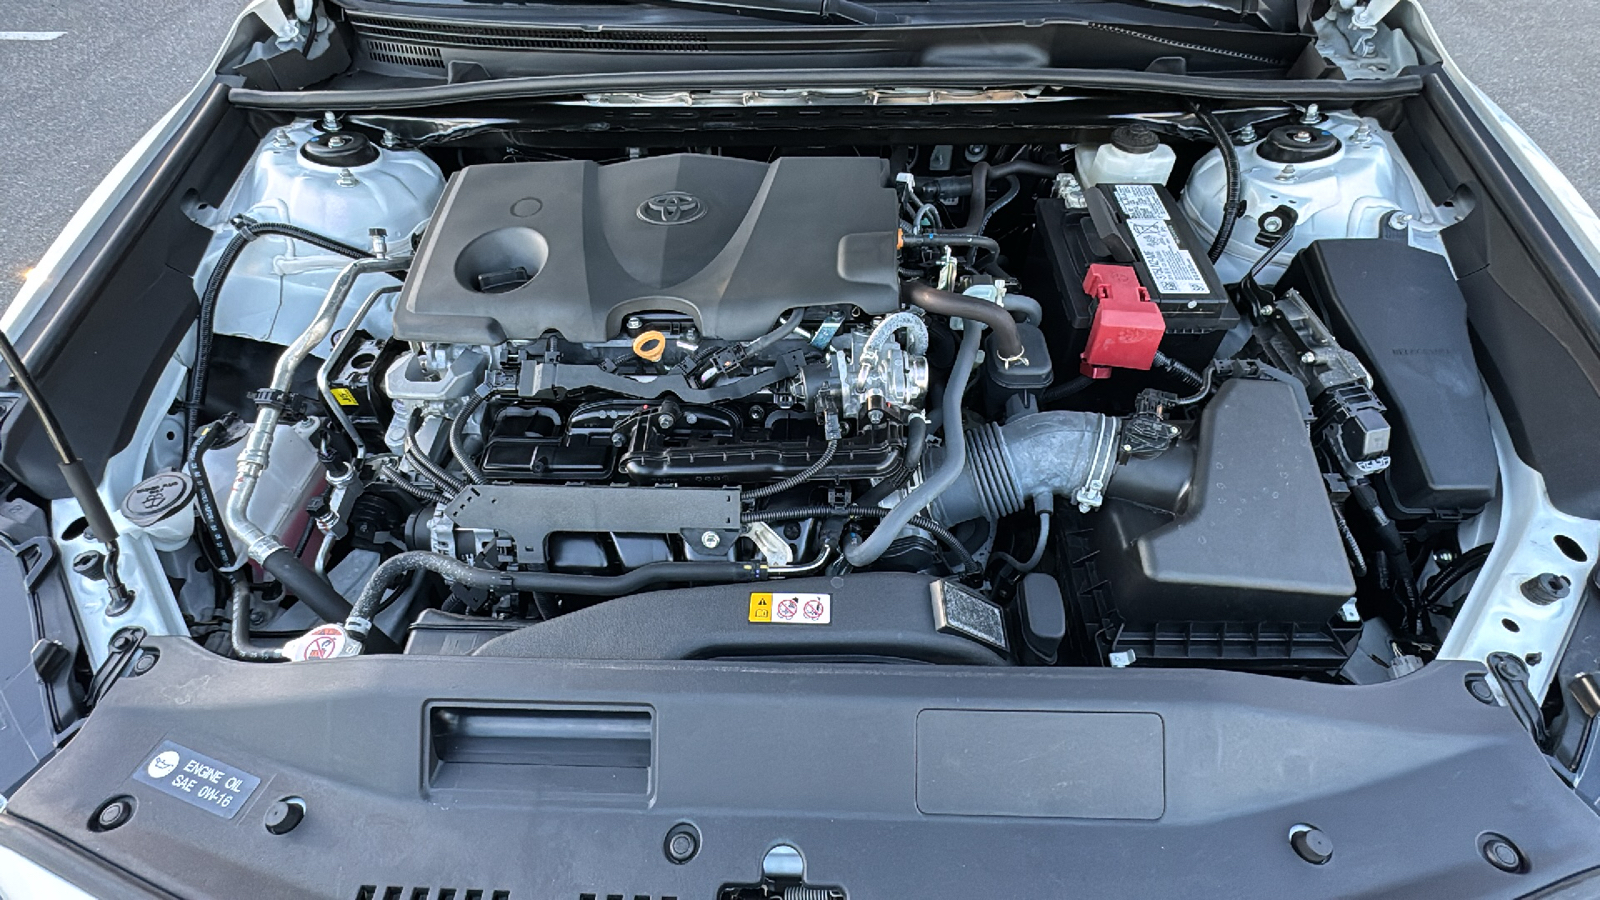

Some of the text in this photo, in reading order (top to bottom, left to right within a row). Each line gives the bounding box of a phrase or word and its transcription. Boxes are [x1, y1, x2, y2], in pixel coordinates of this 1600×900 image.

[172, 775, 233, 807] SAE 0W-16
[183, 760, 242, 792] ENGINE OIL
